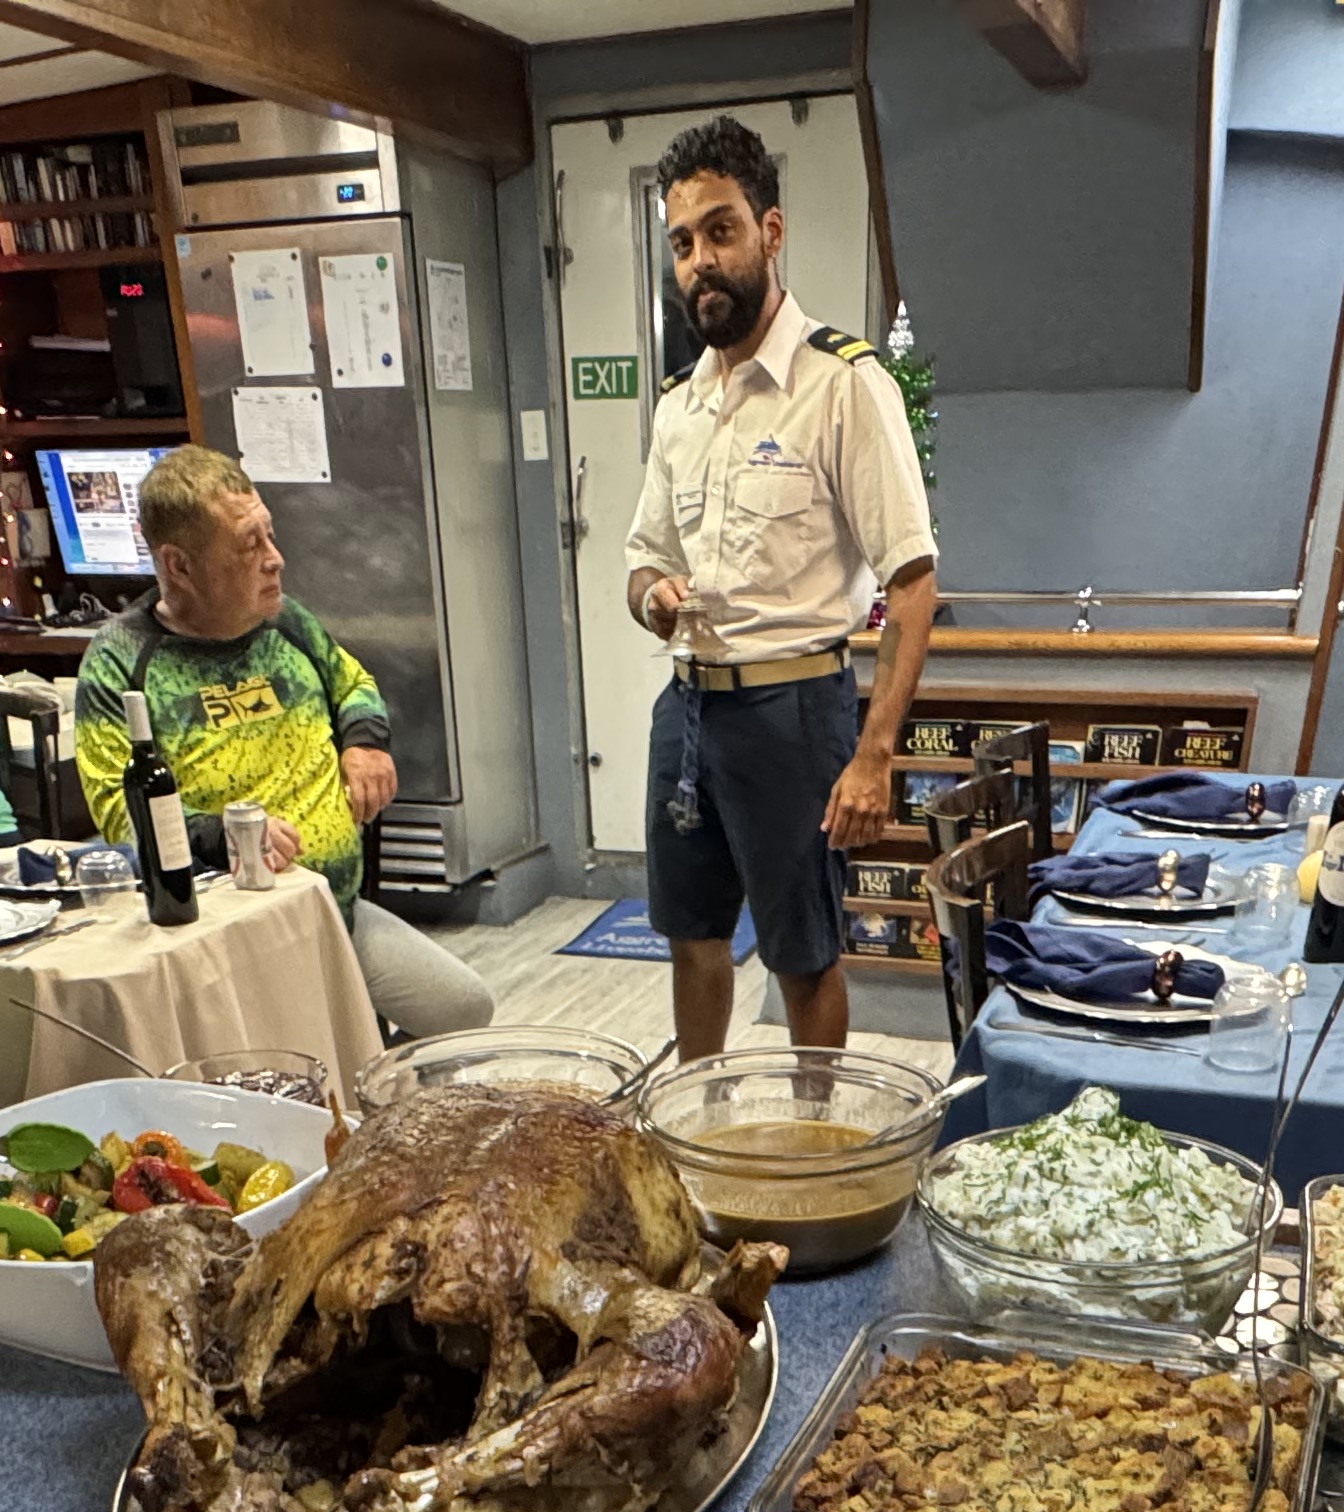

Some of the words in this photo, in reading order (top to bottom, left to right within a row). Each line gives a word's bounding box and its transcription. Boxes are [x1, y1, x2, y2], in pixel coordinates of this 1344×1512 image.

[578, 361, 633, 395] EXIT
[914, 726, 952, 740] REEF
[1104, 733, 1143, 747] REEF
[906, 738, 959, 751] CORAL
[1186, 736, 1227, 750] REEF
[1104, 745, 1141, 759] FISH
[858, 870, 892, 882] REEF
[858, 880, 892, 894] FISH
